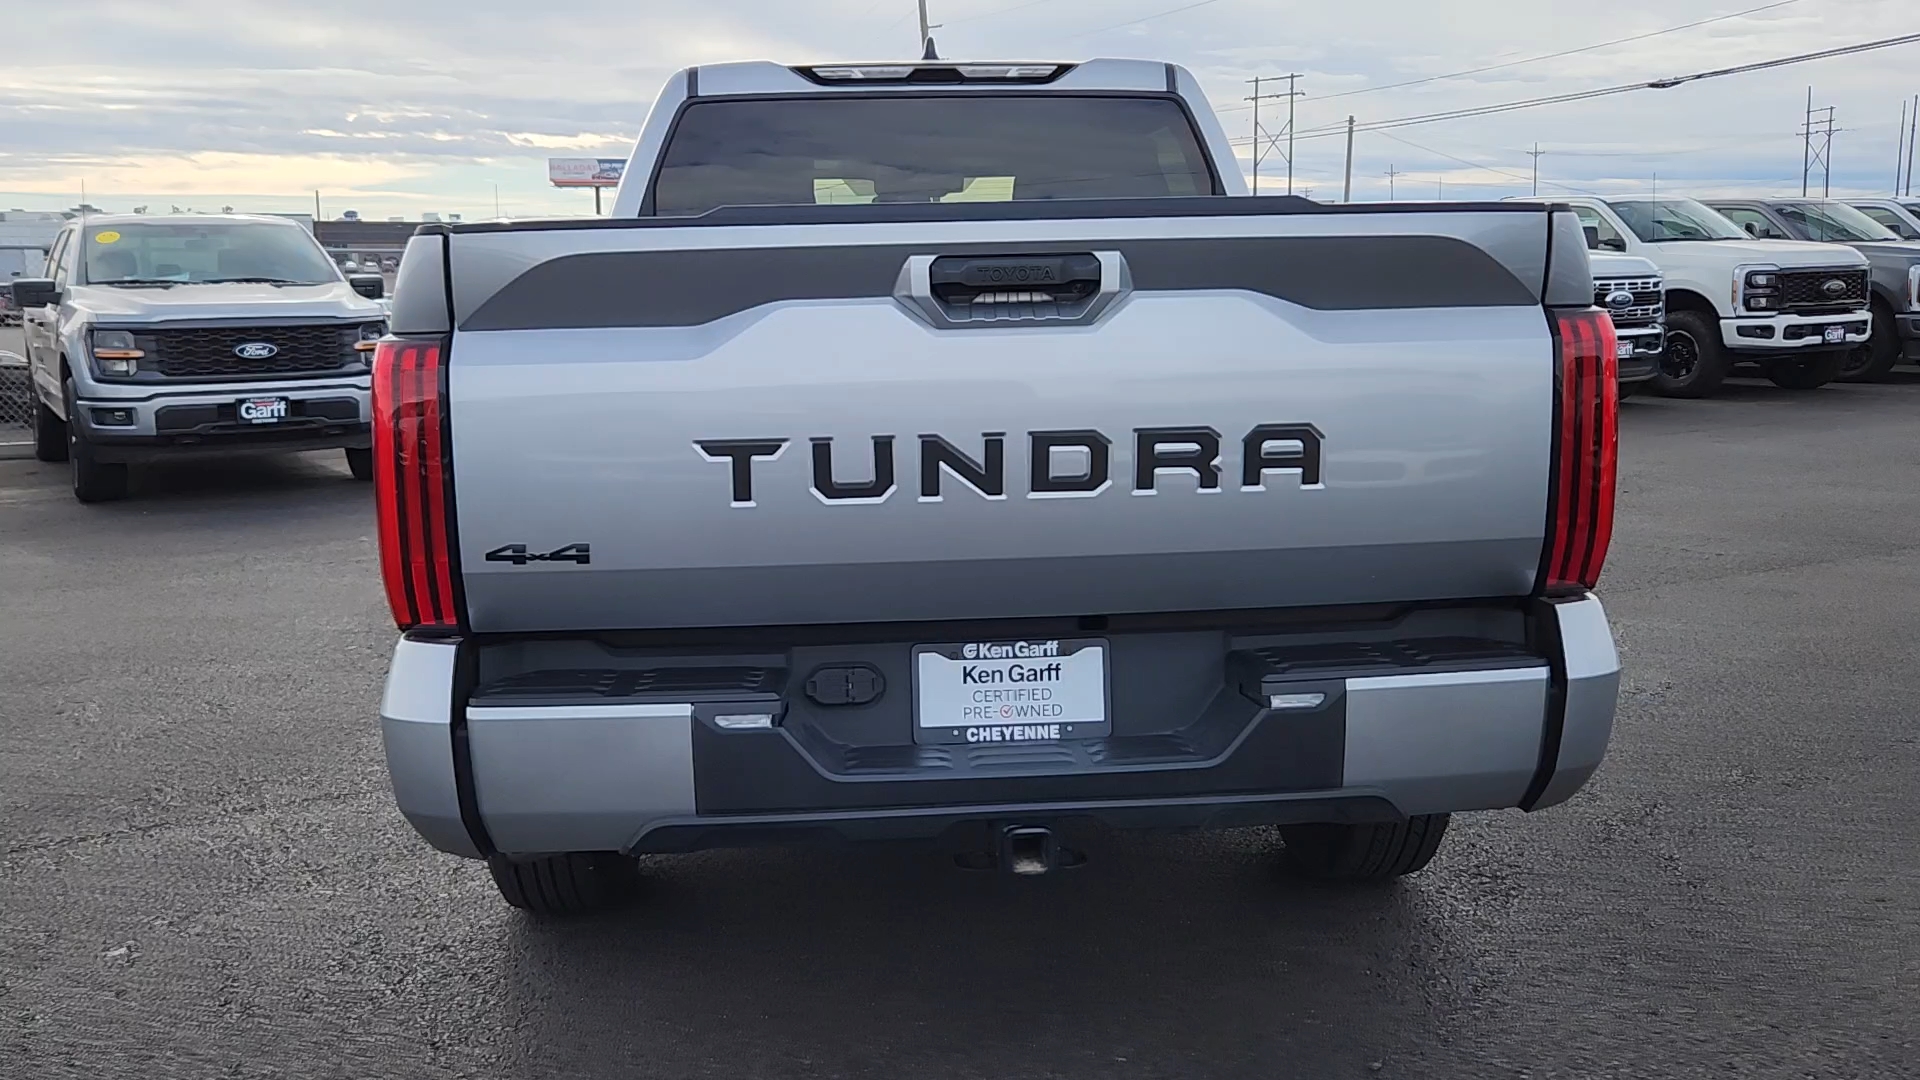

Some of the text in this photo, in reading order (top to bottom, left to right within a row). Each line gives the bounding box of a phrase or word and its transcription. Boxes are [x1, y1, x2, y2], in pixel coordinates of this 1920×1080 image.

[977, 266, 1056, 282] TOYOTA
[242, 344, 271, 357] Ford
[1616, 342, 1633, 355] arff
[241, 401, 287, 419] Garff
[692, 421, 1326, 508] TUNDRA
[485, 543, 590, 565] 4x4
[979, 641, 1059, 658] Ken Garff
[962, 663, 1062, 684] Ken Garff
[972, 688, 1053, 703] CERTIFIED
[966, 725, 1061, 742] CHEYENNE
